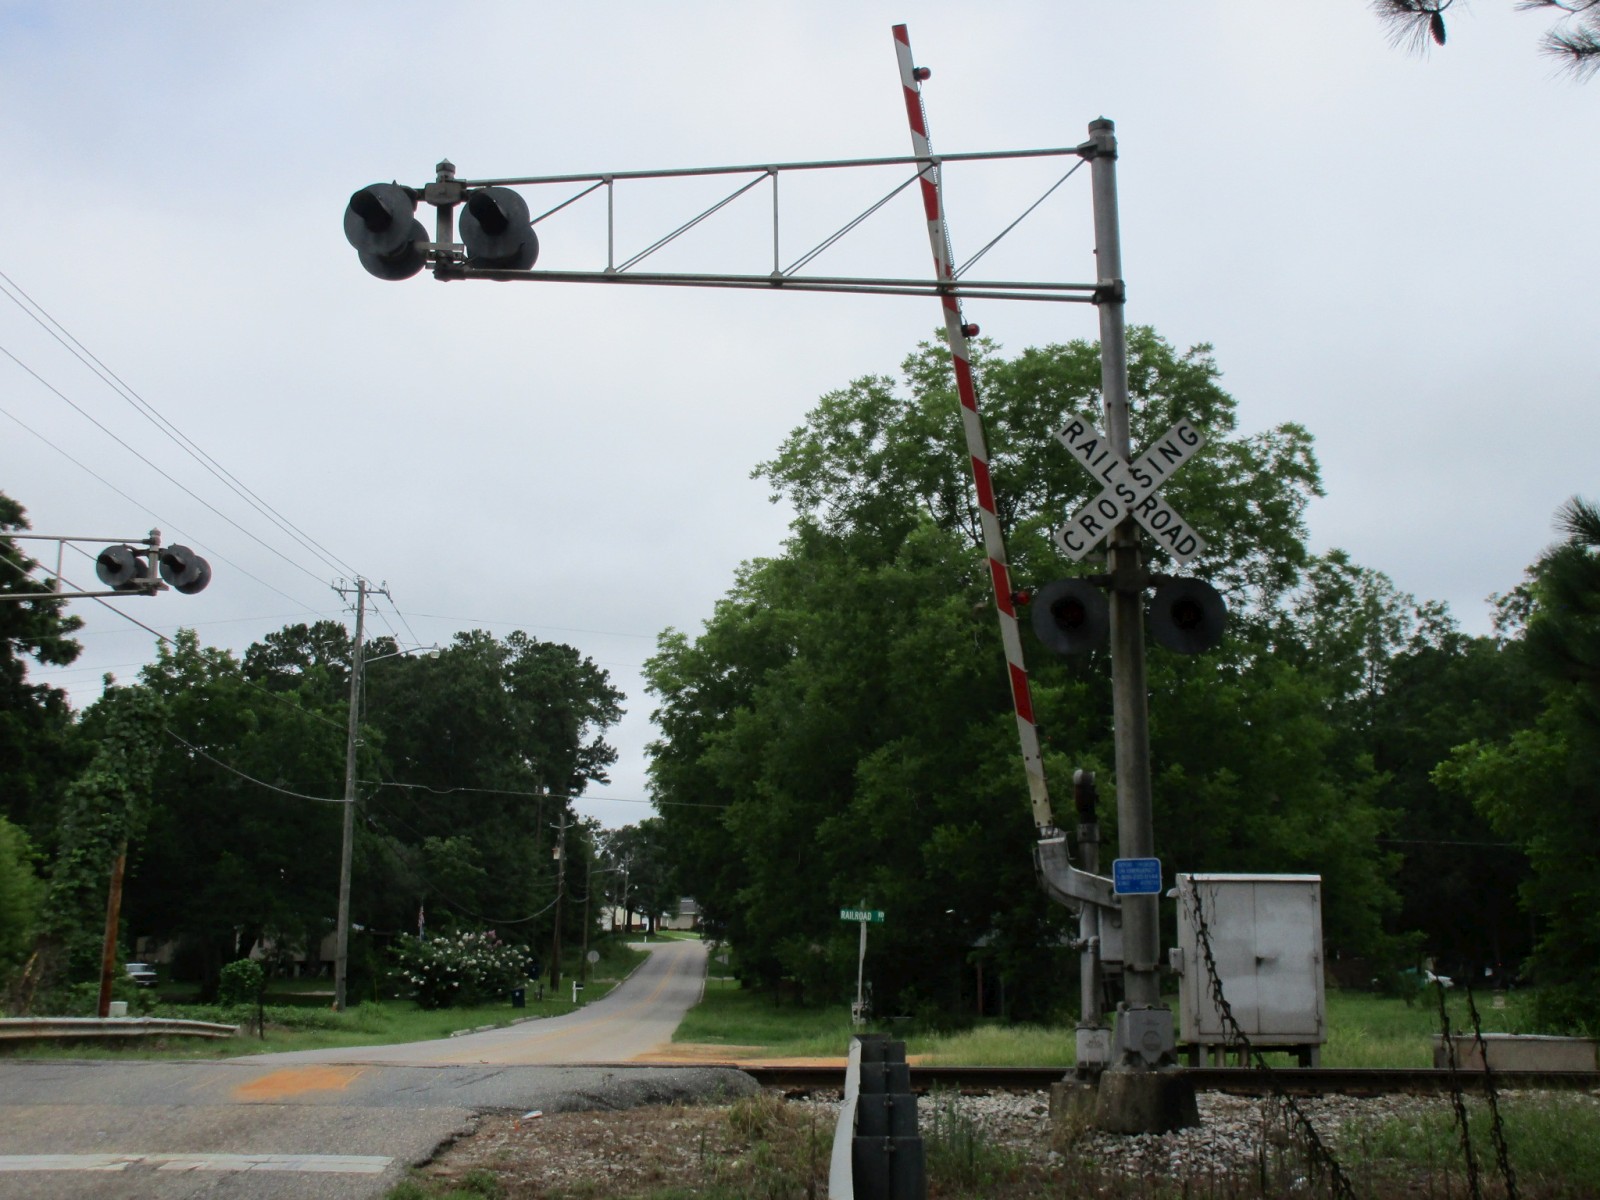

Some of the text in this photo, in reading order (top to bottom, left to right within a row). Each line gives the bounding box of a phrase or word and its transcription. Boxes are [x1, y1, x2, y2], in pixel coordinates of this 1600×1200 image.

[1061, 420, 1197, 556] RAIL ROAD
[1063, 425, 1199, 552] CROSSING
[840, 910, 872, 921] RAILROAD
